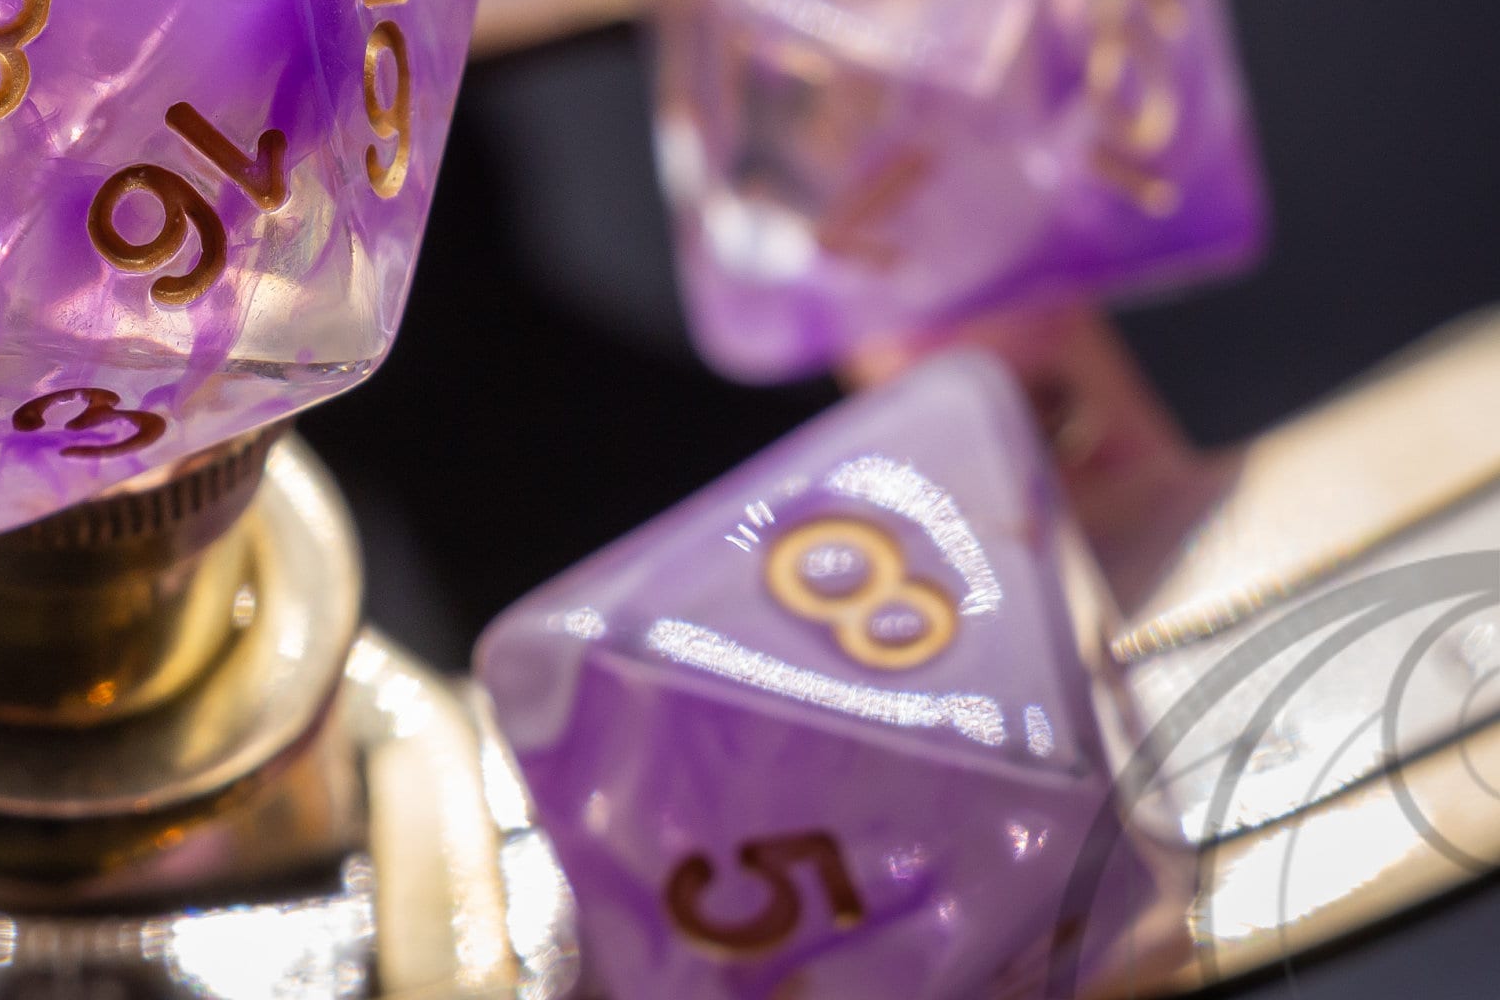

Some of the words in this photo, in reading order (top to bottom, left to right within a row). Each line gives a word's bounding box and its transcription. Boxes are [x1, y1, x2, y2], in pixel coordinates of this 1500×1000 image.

[12, 387, 167, 459] 3
[765, 516, 958, 670] 8
[662, 830, 865, 963] 5
